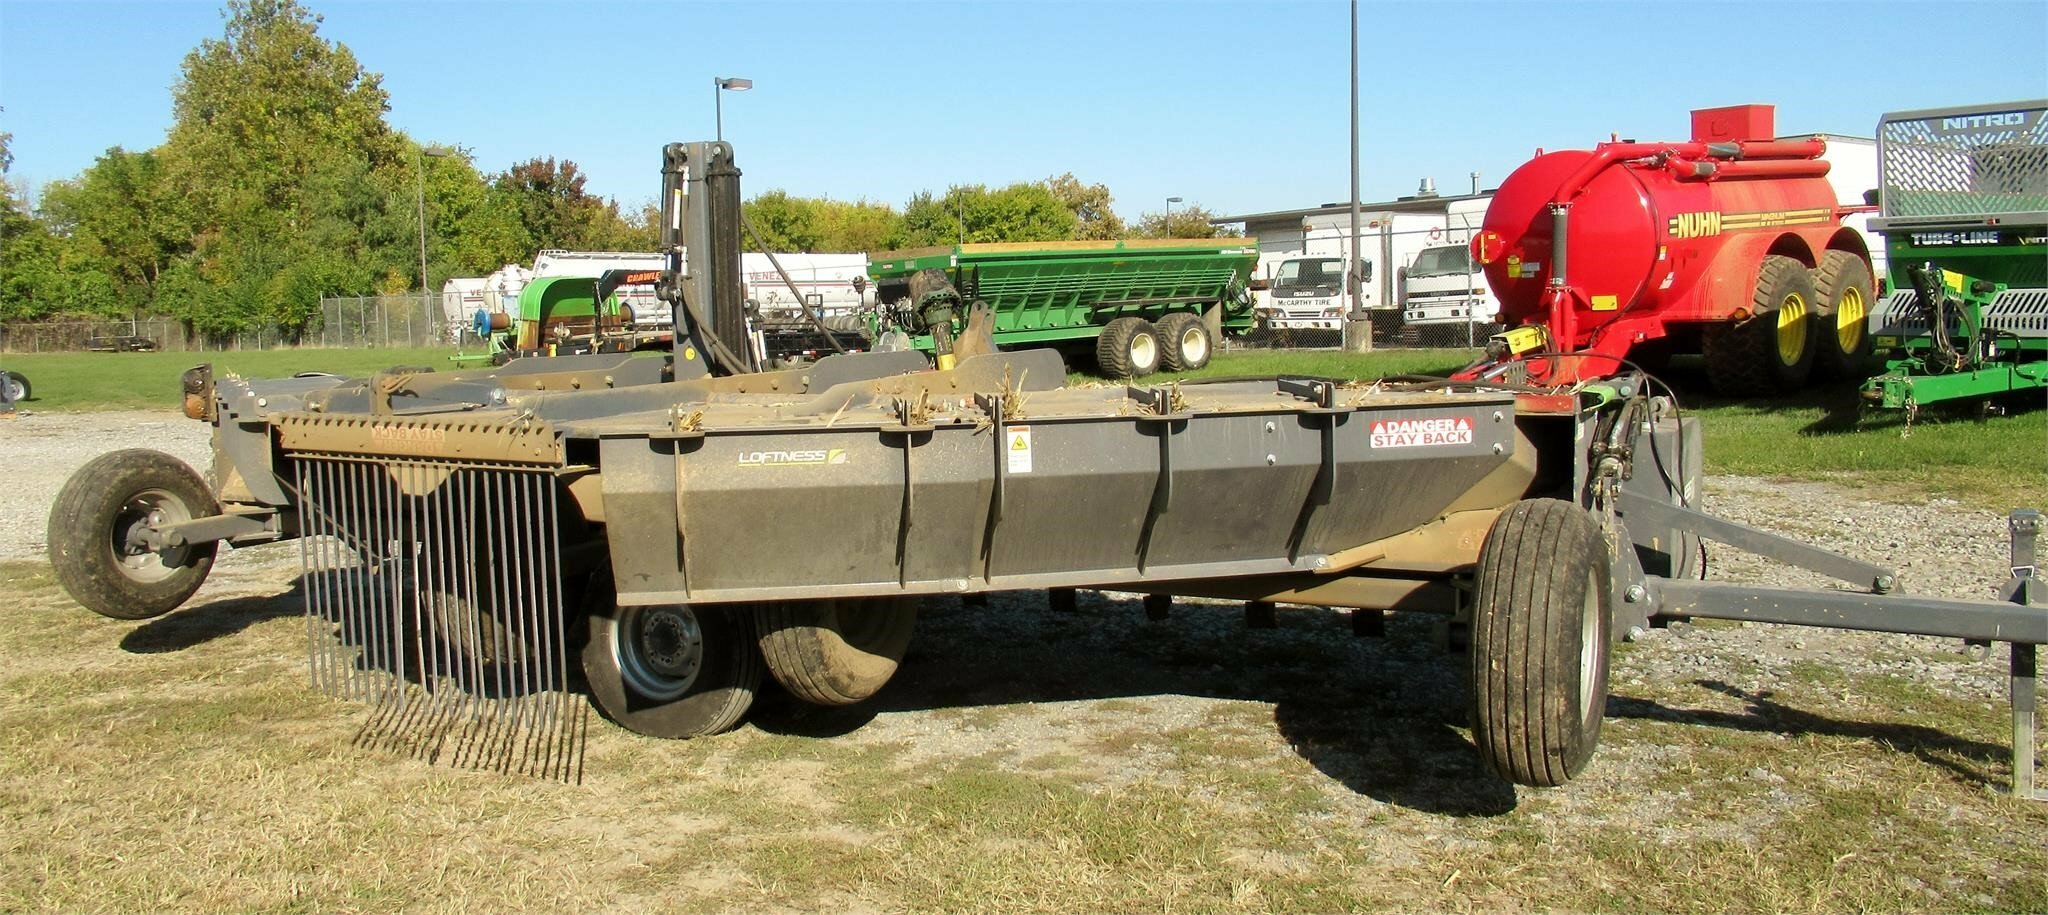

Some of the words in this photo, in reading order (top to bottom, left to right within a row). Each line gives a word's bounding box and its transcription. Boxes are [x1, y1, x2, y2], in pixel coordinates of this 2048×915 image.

[1943, 112, 2025, 130] NITRO
[1677, 211, 1721, 239] NUHN
[627, 271, 662, 283] CRAWLE
[1387, 419, 1456, 433] DANGER
[1374, 434, 1417, 446] STAY
[1423, 431, 1468, 444] BACK
[739, 450, 827, 464] LOFTNESS
